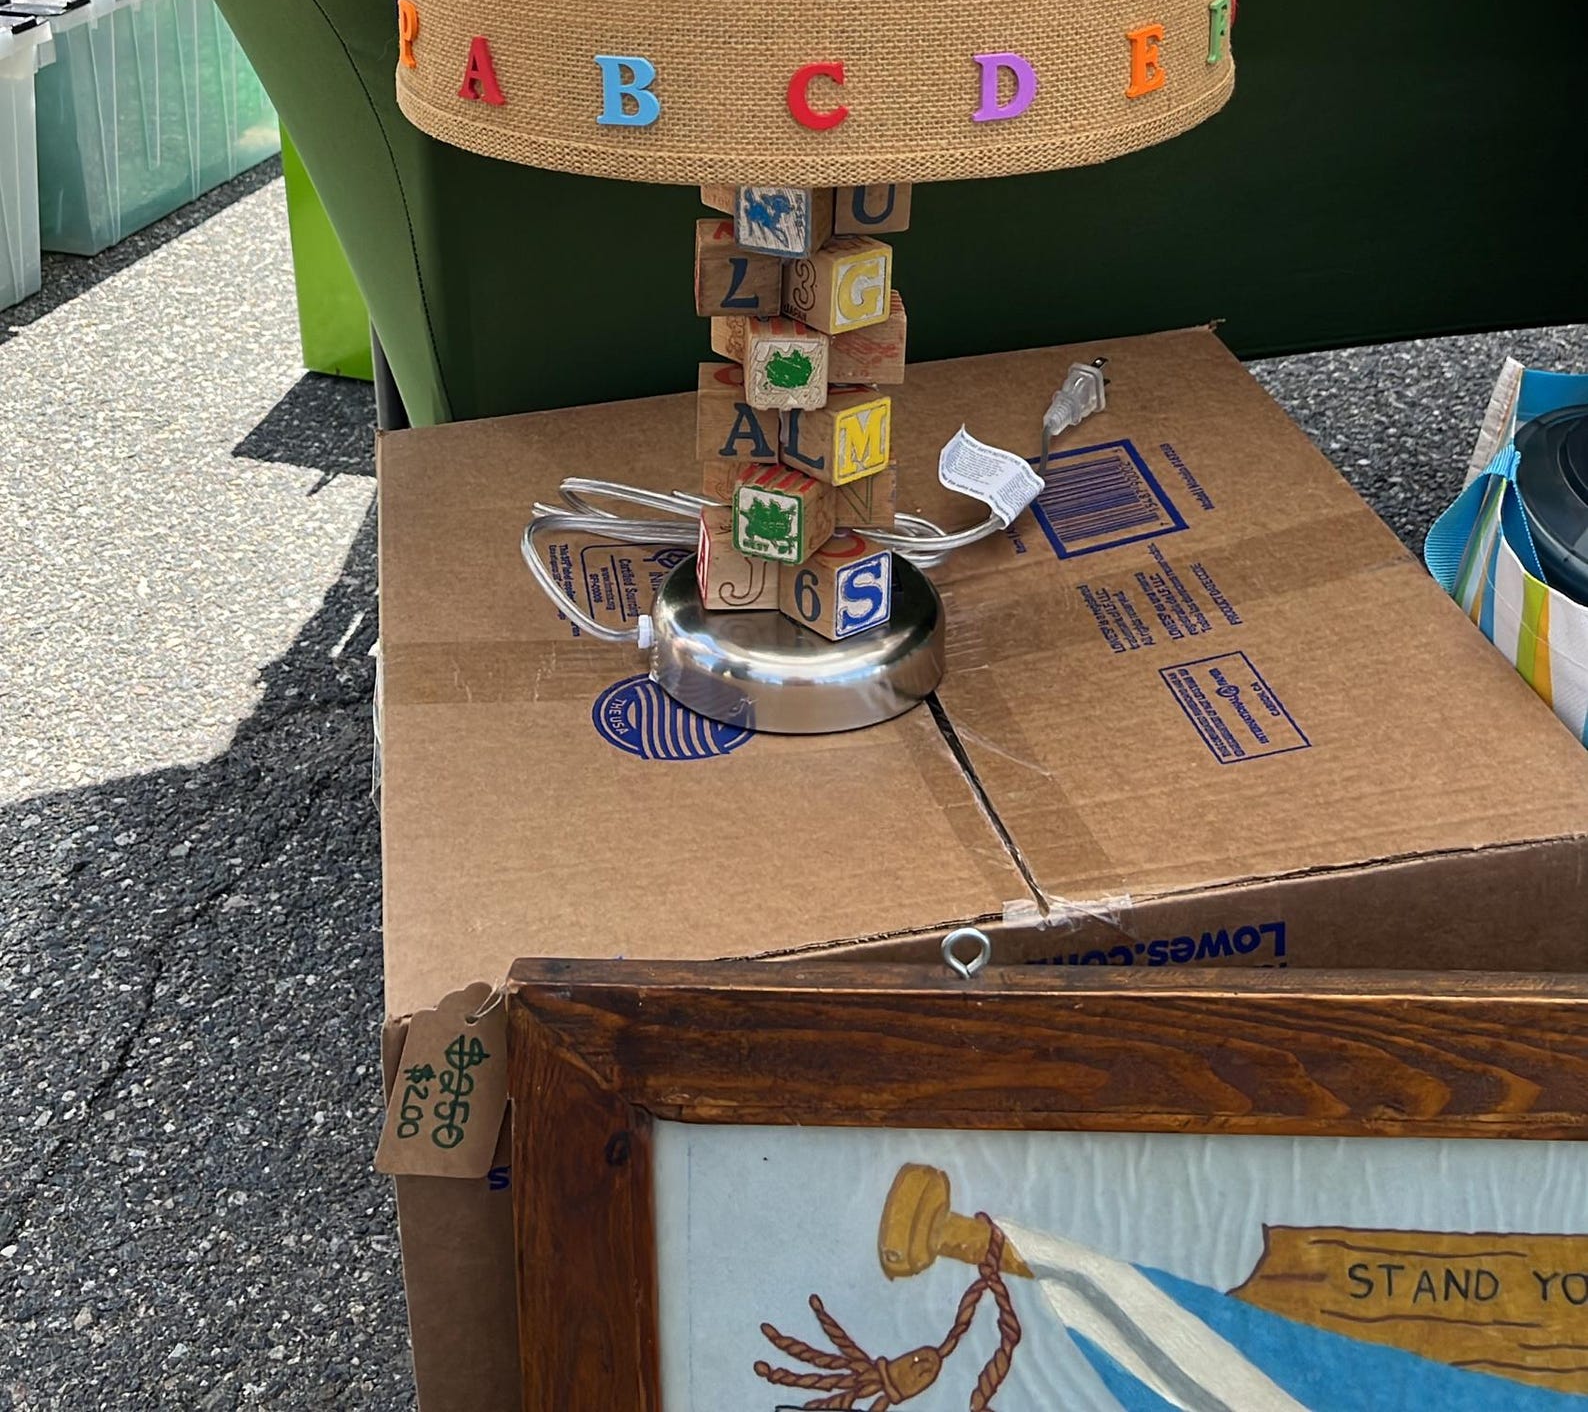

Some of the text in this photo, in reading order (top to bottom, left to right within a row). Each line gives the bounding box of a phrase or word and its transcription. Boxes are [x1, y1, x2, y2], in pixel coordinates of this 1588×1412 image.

[457, 35, 507, 105] A
[594, 55, 661, 127] B
[786, 62, 850, 131] C
[972, 52, 1039, 123] D
[1125, 23, 1166, 99] E
[793, 258, 816, 311] 3
[838, 261, 881, 321] G
[718, 402, 776, 457] A
[839, 408, 886, 474] M
[619, 558, 637, 586] Certified
[795, 569, 821, 622] 6
[841, 555, 883, 631] S
[1210, 592, 1244, 626] PRODUCT
[608, 697, 629, 735] THE USA
[396, 1063, 437, 1138] $200
[1347, 1262, 1500, 1304] STAND
